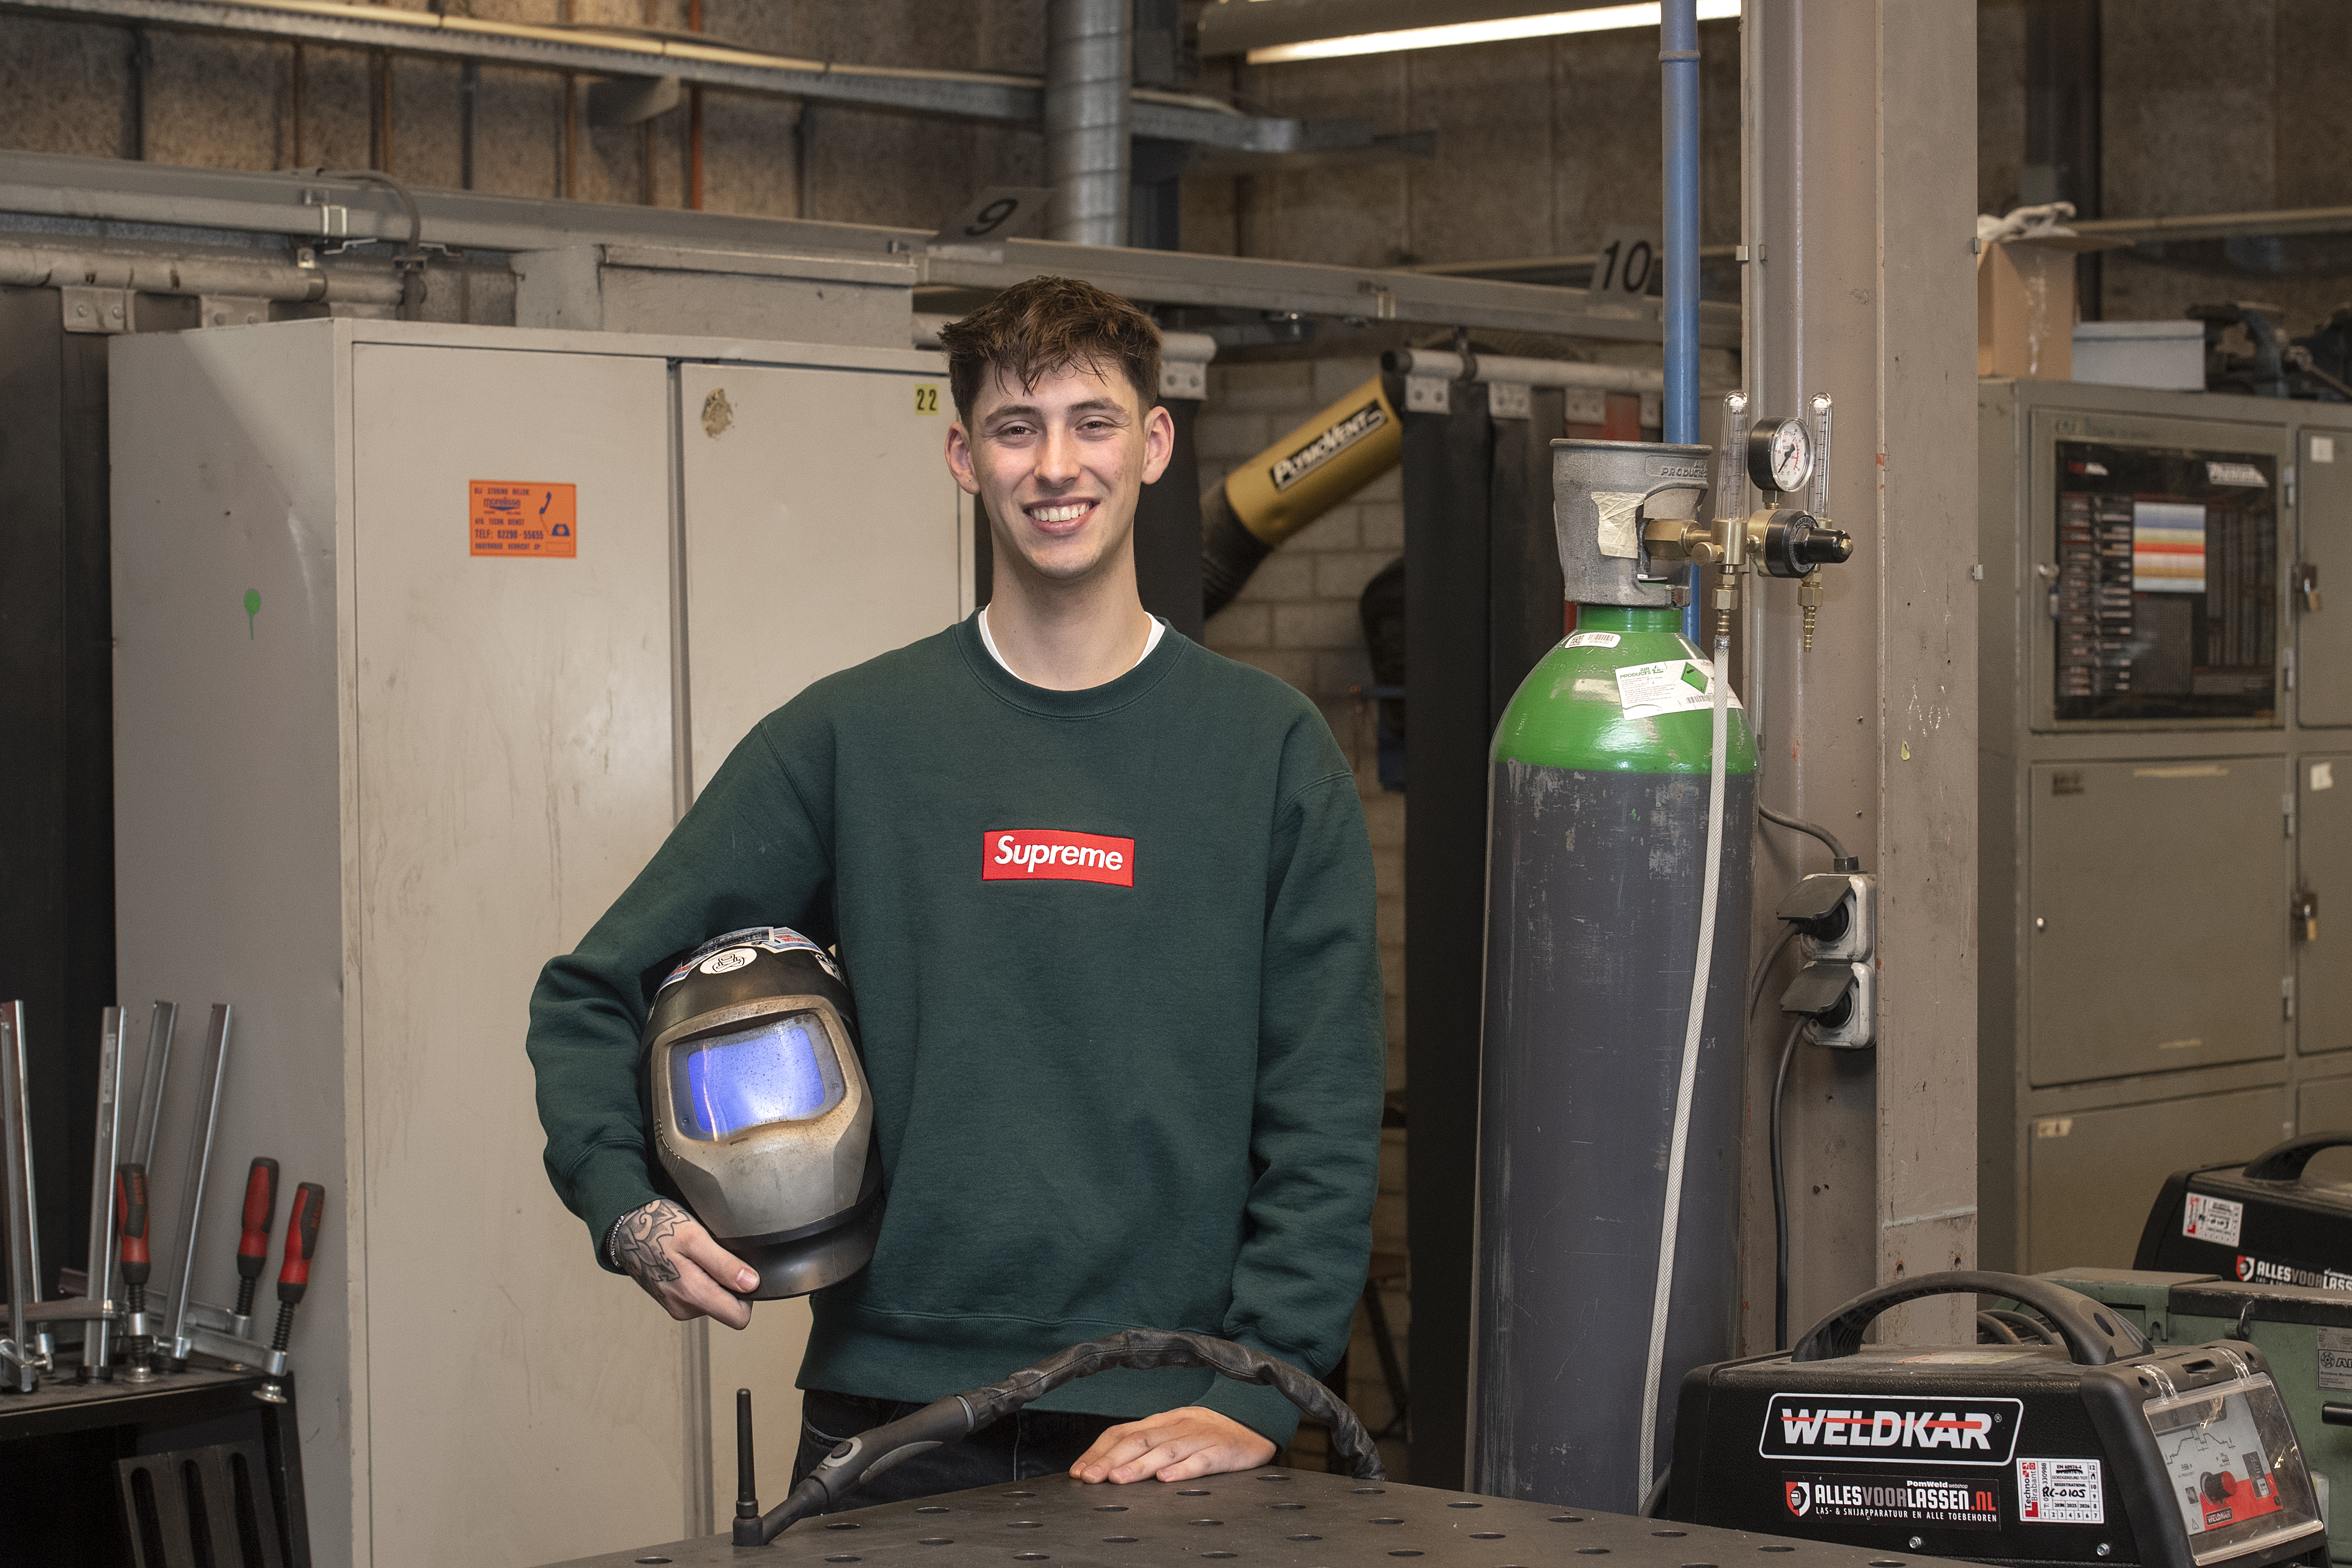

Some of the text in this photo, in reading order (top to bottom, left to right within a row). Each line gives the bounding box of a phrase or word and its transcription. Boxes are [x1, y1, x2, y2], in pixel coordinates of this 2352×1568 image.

[1603, 240, 1651, 293] 10
[917, 388, 936, 411] 22
[1795, 518, 1814, 528] HARRIS
[1620, 670, 1651, 678] PRODUCTS
[994, 835, 1123, 873] Supreme
[1781, 1408, 1993, 1450] WELDKAR
[1907, 1480, 1948, 1488] PomWeld
[1815, 1484, 1996, 1511] ALLESVOORLASSEN.NL
[1843, 1508, 1908, 1518] SNIJAPPARATUUR
[1927, 1512, 1944, 1520] ALLE
[1948, 1513, 1997, 1522] TOEBEHOREN
